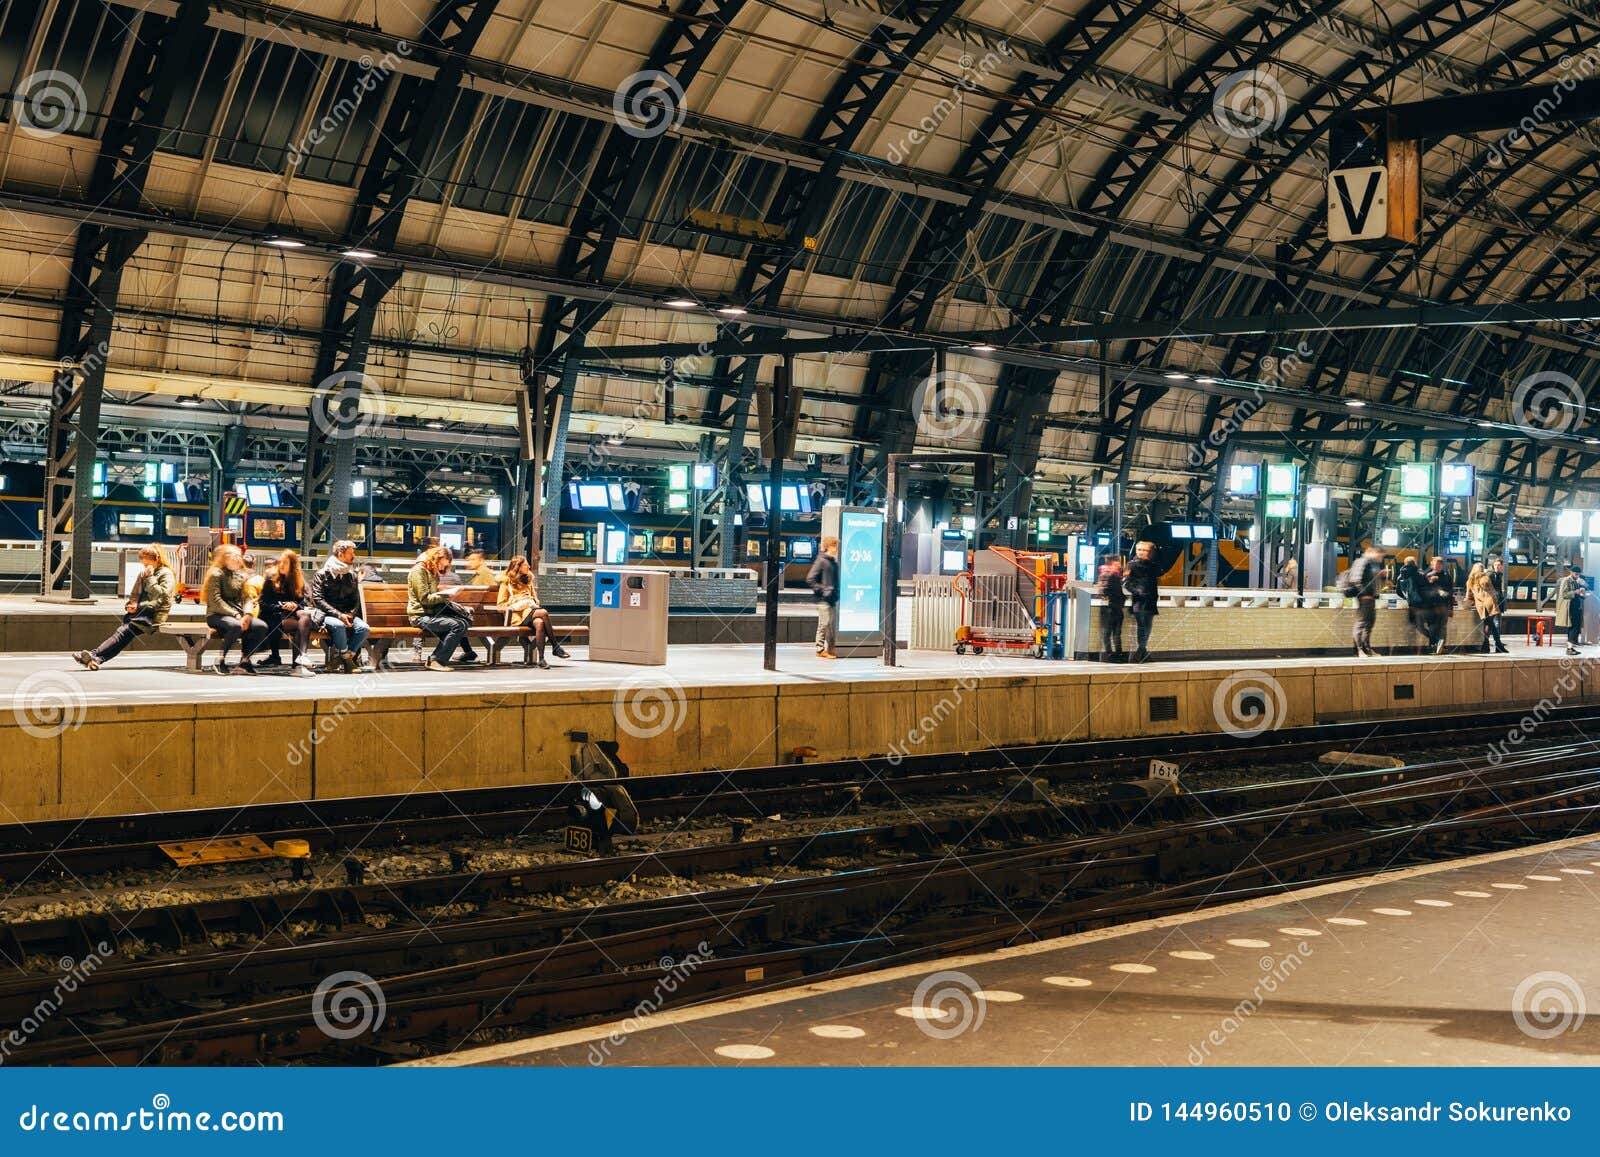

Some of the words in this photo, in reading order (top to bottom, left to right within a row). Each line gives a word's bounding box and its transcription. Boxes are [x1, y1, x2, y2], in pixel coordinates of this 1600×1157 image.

[1333, 171, 1382, 235] V
[808, 454, 815, 463] V
[405, 522, 412, 532] 2
[569, 830, 588, 849] 158
